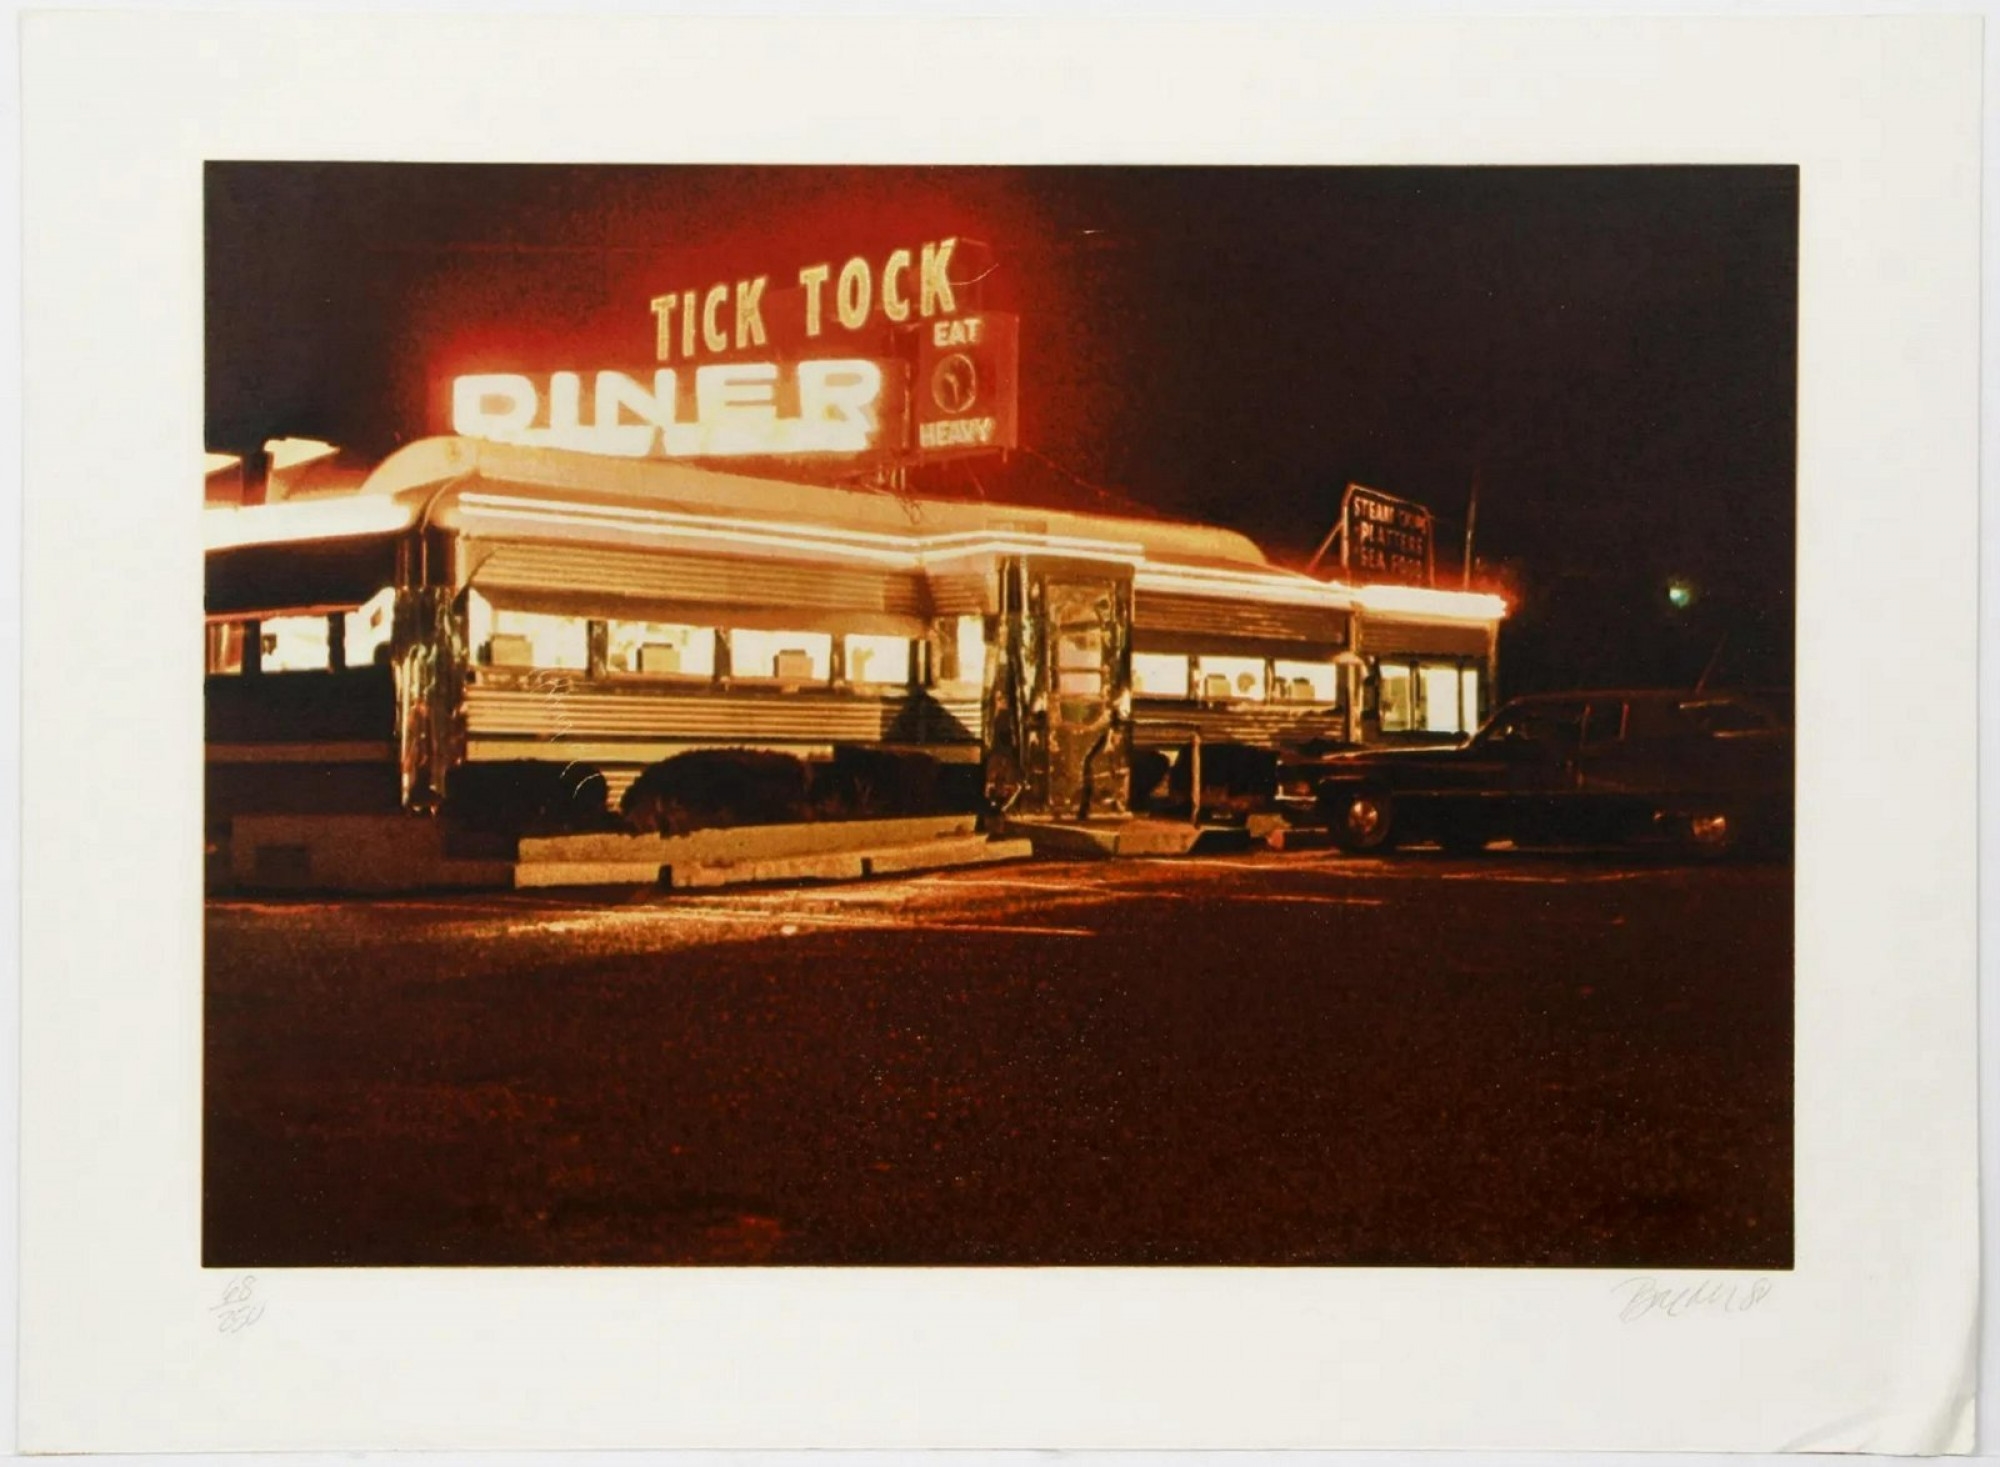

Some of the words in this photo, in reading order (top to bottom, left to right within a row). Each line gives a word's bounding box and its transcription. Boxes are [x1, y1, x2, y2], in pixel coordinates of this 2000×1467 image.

[650, 276, 768, 361] TICK
[799, 237, 957, 336] TOCK
[933, 316, 981, 347] EAT
[452, 357, 882, 456] DINER
[919, 416, 995, 448] HEAVY
